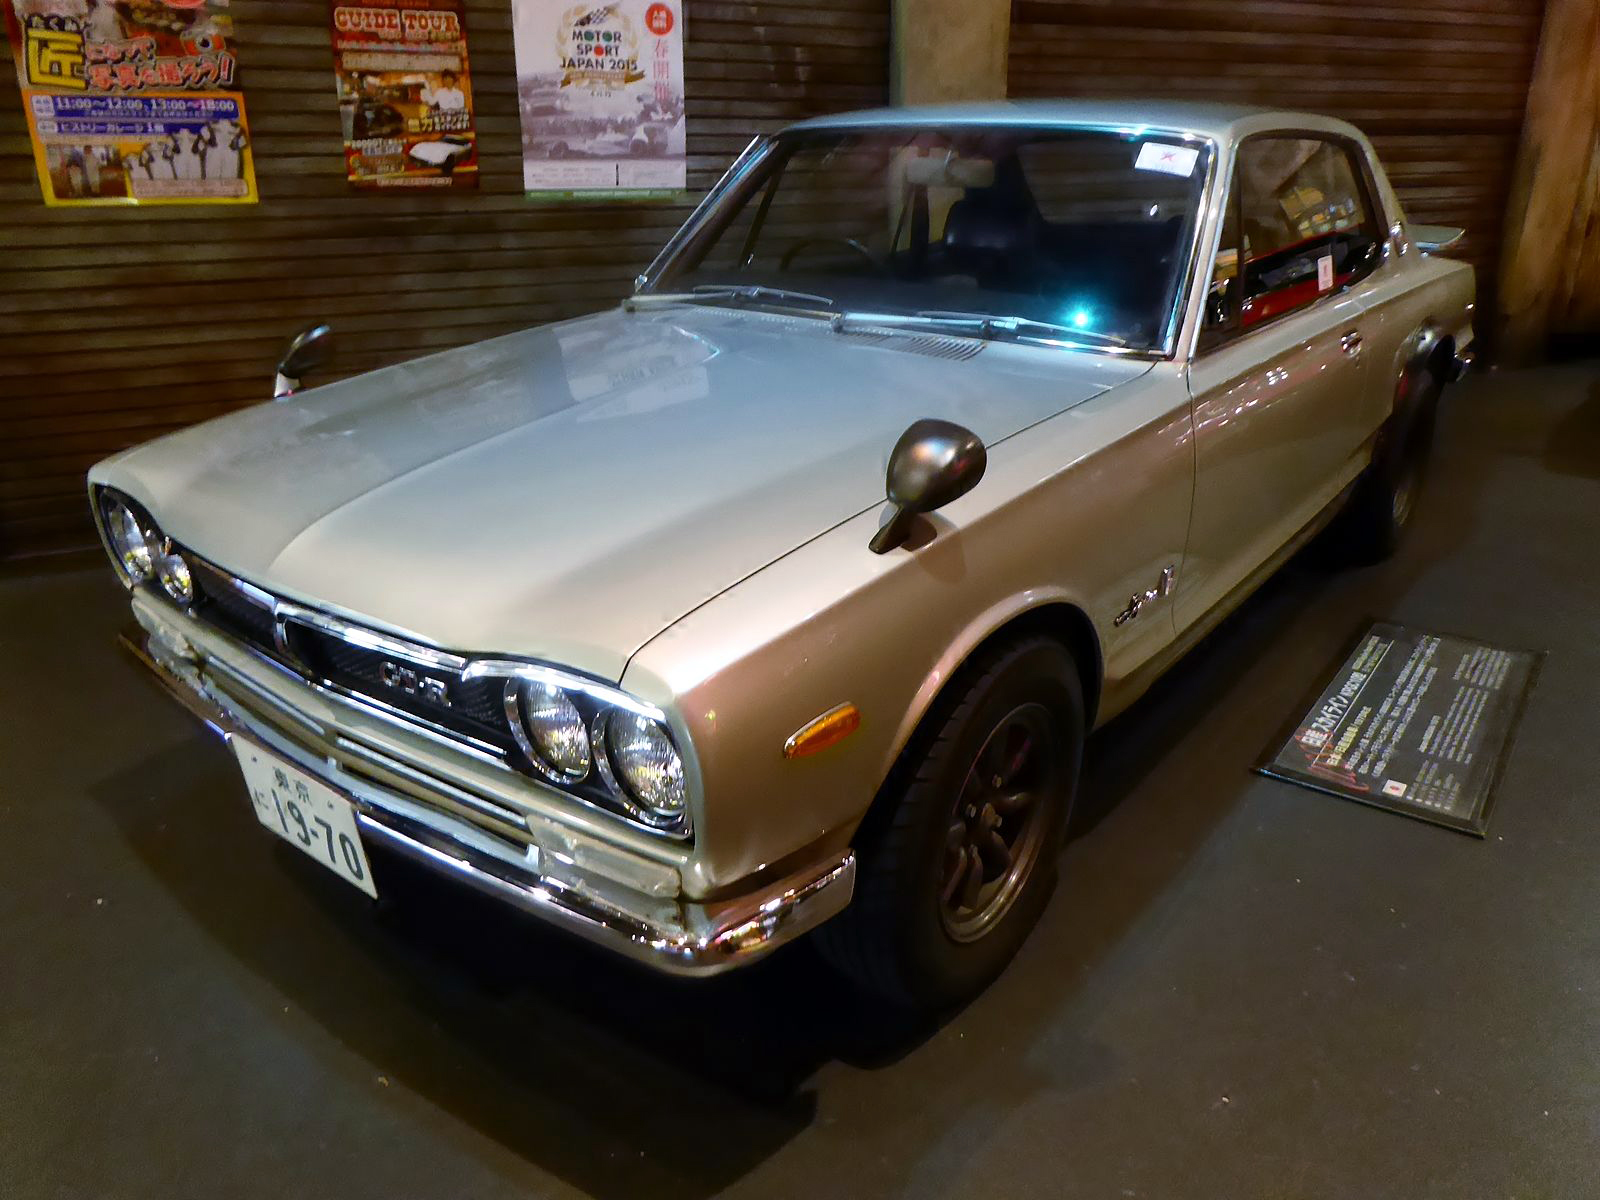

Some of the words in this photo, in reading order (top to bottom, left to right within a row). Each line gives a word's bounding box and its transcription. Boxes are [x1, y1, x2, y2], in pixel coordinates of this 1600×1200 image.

[335, 11, 400, 30] GUIDE
[403, 13, 459, 32] TOUR
[572, 30, 622, 42] MOTOR
[27, 29, 86, 88] 匠
[560, 58, 604, 70] JAPAN
[609, 59, 637, 70] 2015
[576, 44, 620, 56] SPORT
[1311, 695, 1348, 733] スカイライン
[273, 766, 313, 807] 東京
[271, 788, 364, 881] 19-70
